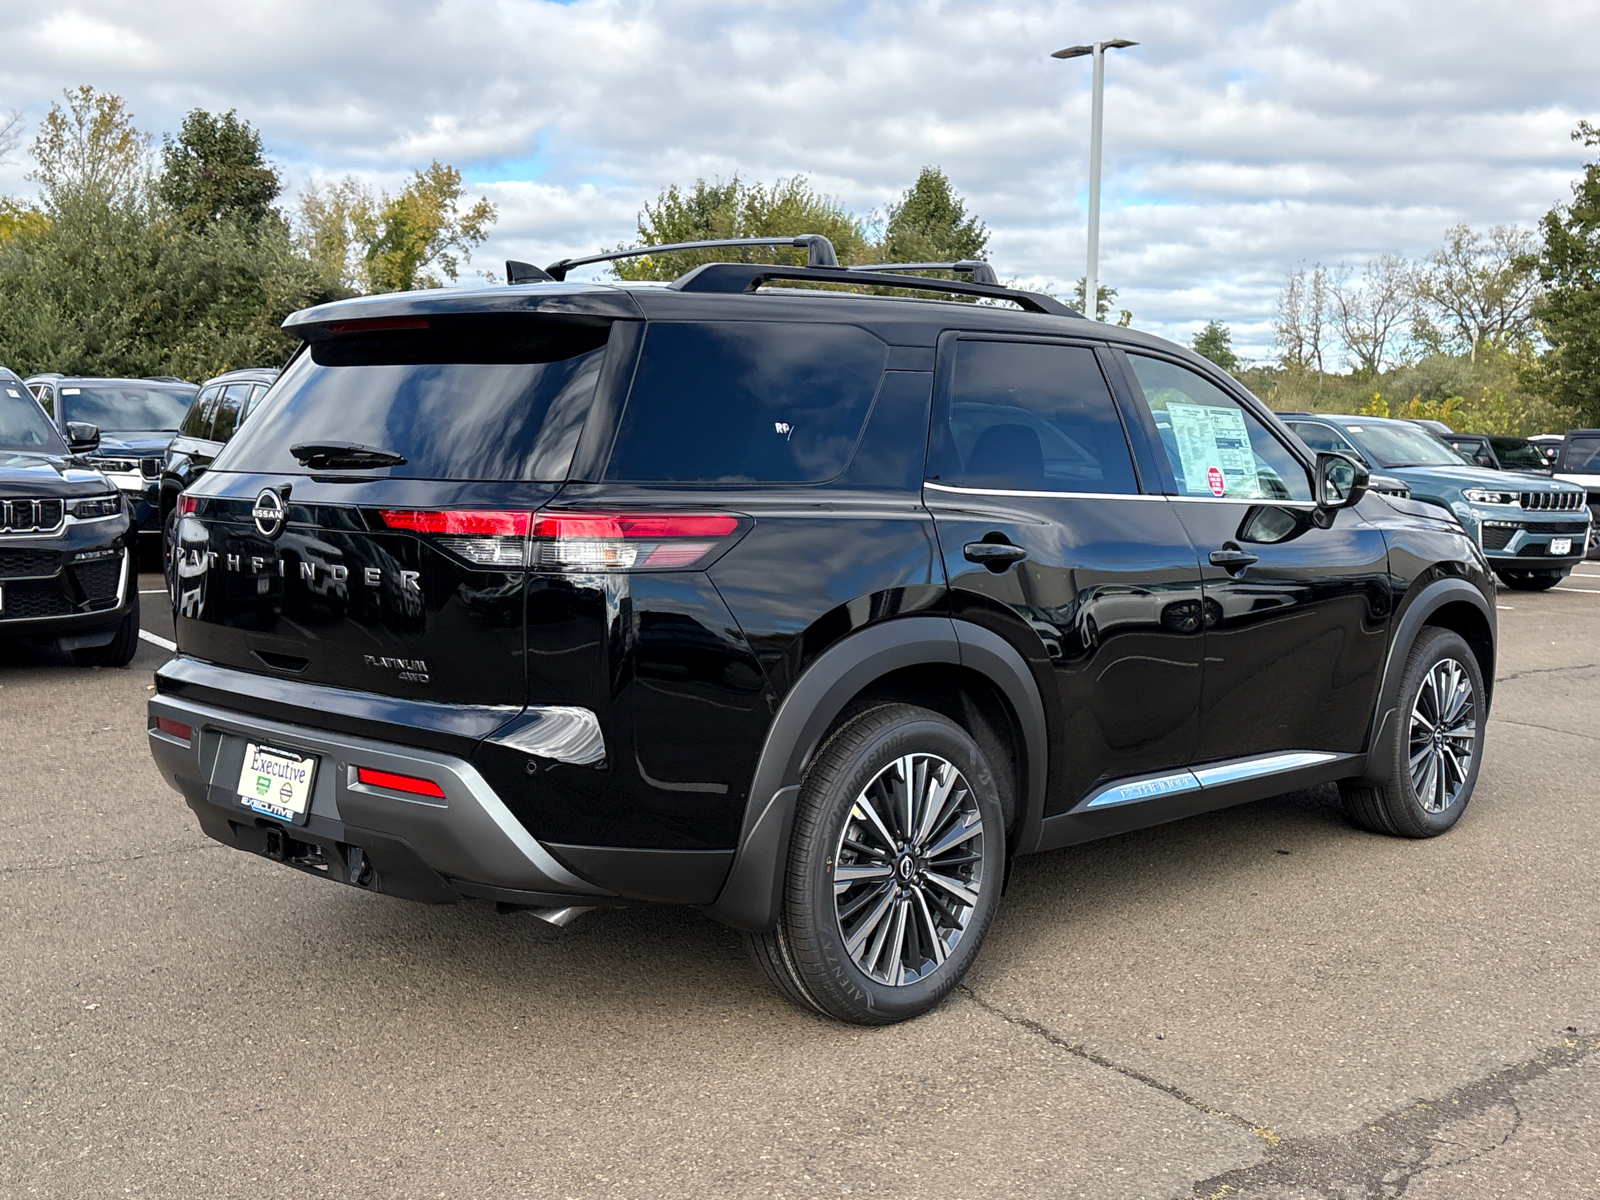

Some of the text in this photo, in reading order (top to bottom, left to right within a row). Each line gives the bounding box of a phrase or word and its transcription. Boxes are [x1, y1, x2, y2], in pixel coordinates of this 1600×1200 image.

[252, 508, 283, 519] SSAN
[176, 546, 421, 591] PATHFINDER
[363, 653, 428, 672] PLATINUM
[398, 671, 430, 683] 4WD
[250, 750, 306, 784] Executive
